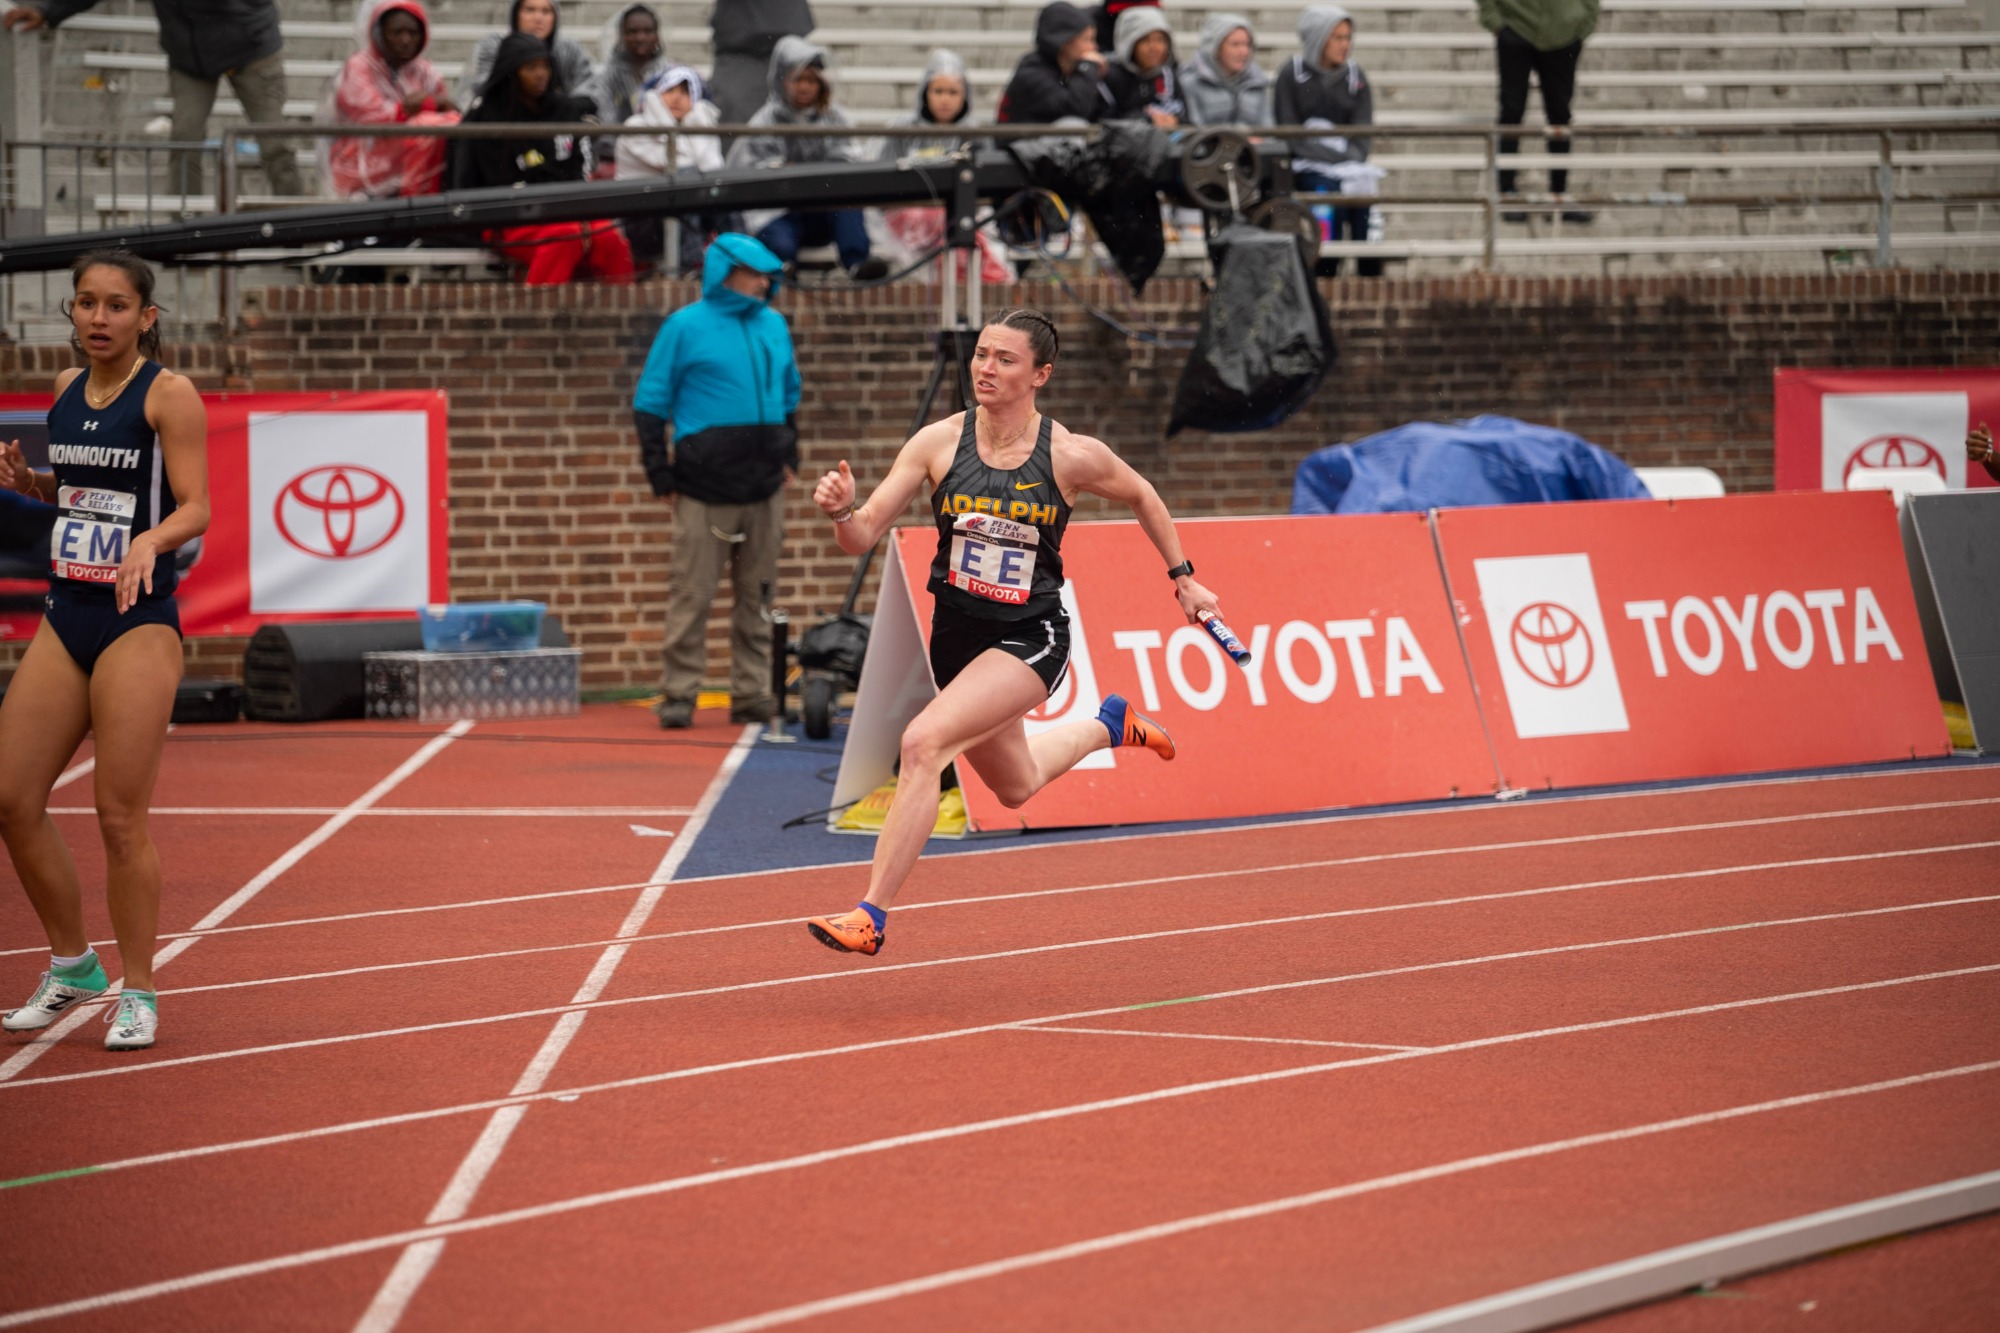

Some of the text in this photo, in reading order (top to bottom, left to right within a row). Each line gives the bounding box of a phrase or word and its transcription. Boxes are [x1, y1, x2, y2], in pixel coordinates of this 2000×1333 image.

[89, 492, 115, 502] PENN
[87, 501, 124, 512] RELAYS
[940, 493, 1058, 525] ADELPHI
[991, 519, 1020, 532] PENN
[966, 531, 988, 542] Dream
[988, 527, 1028, 540] RELAYS
[68, 564, 118, 580] TOYOTA
[971, 580, 1021, 602] TOYOTA
[1624, 586, 1904, 677] TOYOTA
[1112, 617, 1444, 711] TOYOTA
